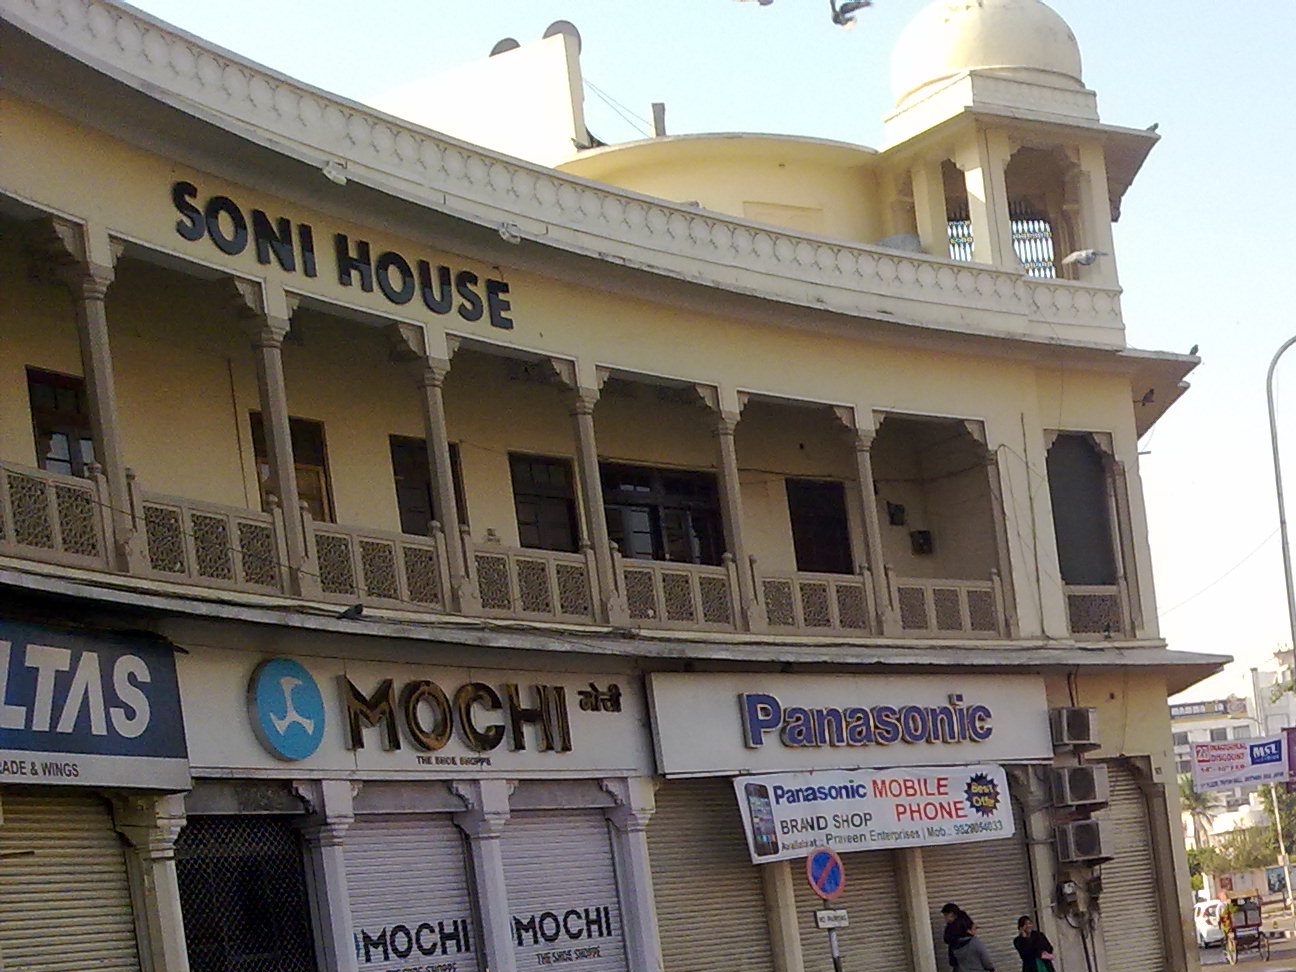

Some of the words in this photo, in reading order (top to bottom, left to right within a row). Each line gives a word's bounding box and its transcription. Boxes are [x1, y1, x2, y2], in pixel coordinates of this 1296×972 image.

[172, 181, 317, 278] SONI
[335, 232, 514, 330] HOUSE
[336, 674, 572, 752] MOCHI
[738, 692, 993, 749] Panasonic
[30, 761, 39, 776] &
[41, 762, 80, 777] WINGS
[416, 755, 433, 765] THE
[773, 779, 867, 805] Panasonic
[872, 777, 949, 799] MOBILE
[780, 815, 828, 835] BRAND
[833, 812, 873, 829] SHOP
[895, 801, 968, 822] PHONE
[825, 833, 867, 845] Praveen
[512, 906, 612, 946] MOCHI
[361, 919, 471, 963] MOCHI
[536, 952, 551, 965] THE
